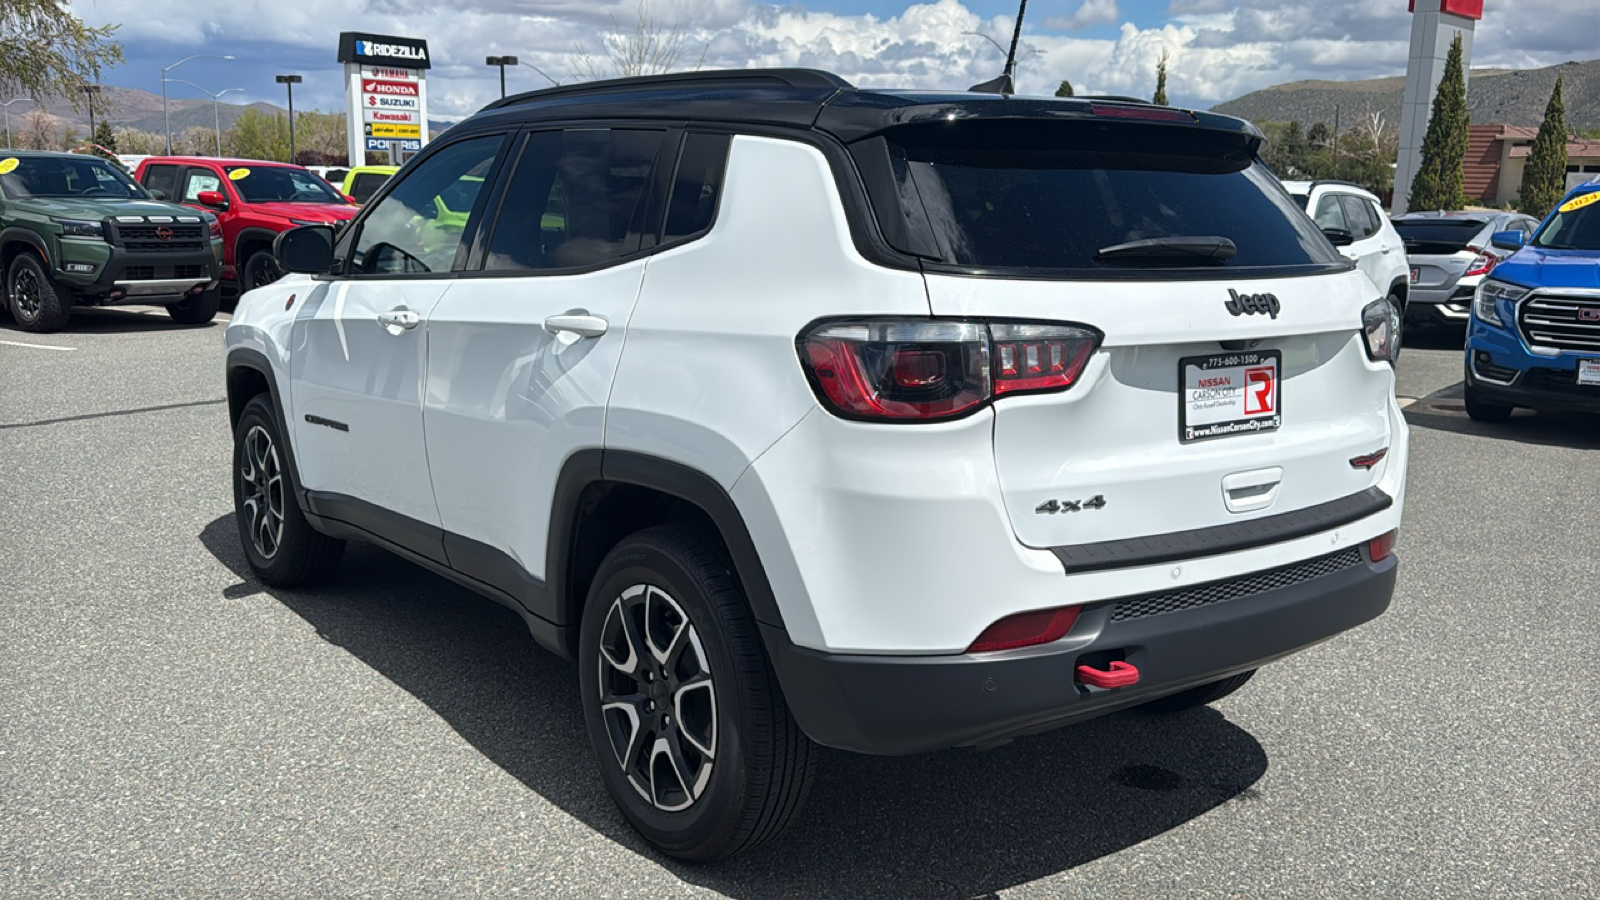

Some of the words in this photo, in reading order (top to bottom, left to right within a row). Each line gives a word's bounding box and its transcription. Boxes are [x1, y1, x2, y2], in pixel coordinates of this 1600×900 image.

[374, 44, 426, 60] RIDEZILLA
[379, 68, 409, 79] YAMAHA
[376, 85, 416, 94] HONDA
[380, 98, 415, 107] SUZUKI
[373, 111, 411, 121] Kawasaki
[368, 139, 420, 150] POLRIS
[1569, 193, 1597, 210] 2024
[1224, 288, 1281, 319] Jeep
[1208, 354, 1258, 367] 775-600-1500
[1198, 376, 1231, 387] NISSAN
[1192, 389, 1221, 400] CARSON
[1222, 386, 1237, 397] CITY
[1215, 400, 1236, 408] Dealership
[1194, 420, 1274, 437] www.NissanCarsonCity.com
[1035, 494, 1106, 515] 4x4
